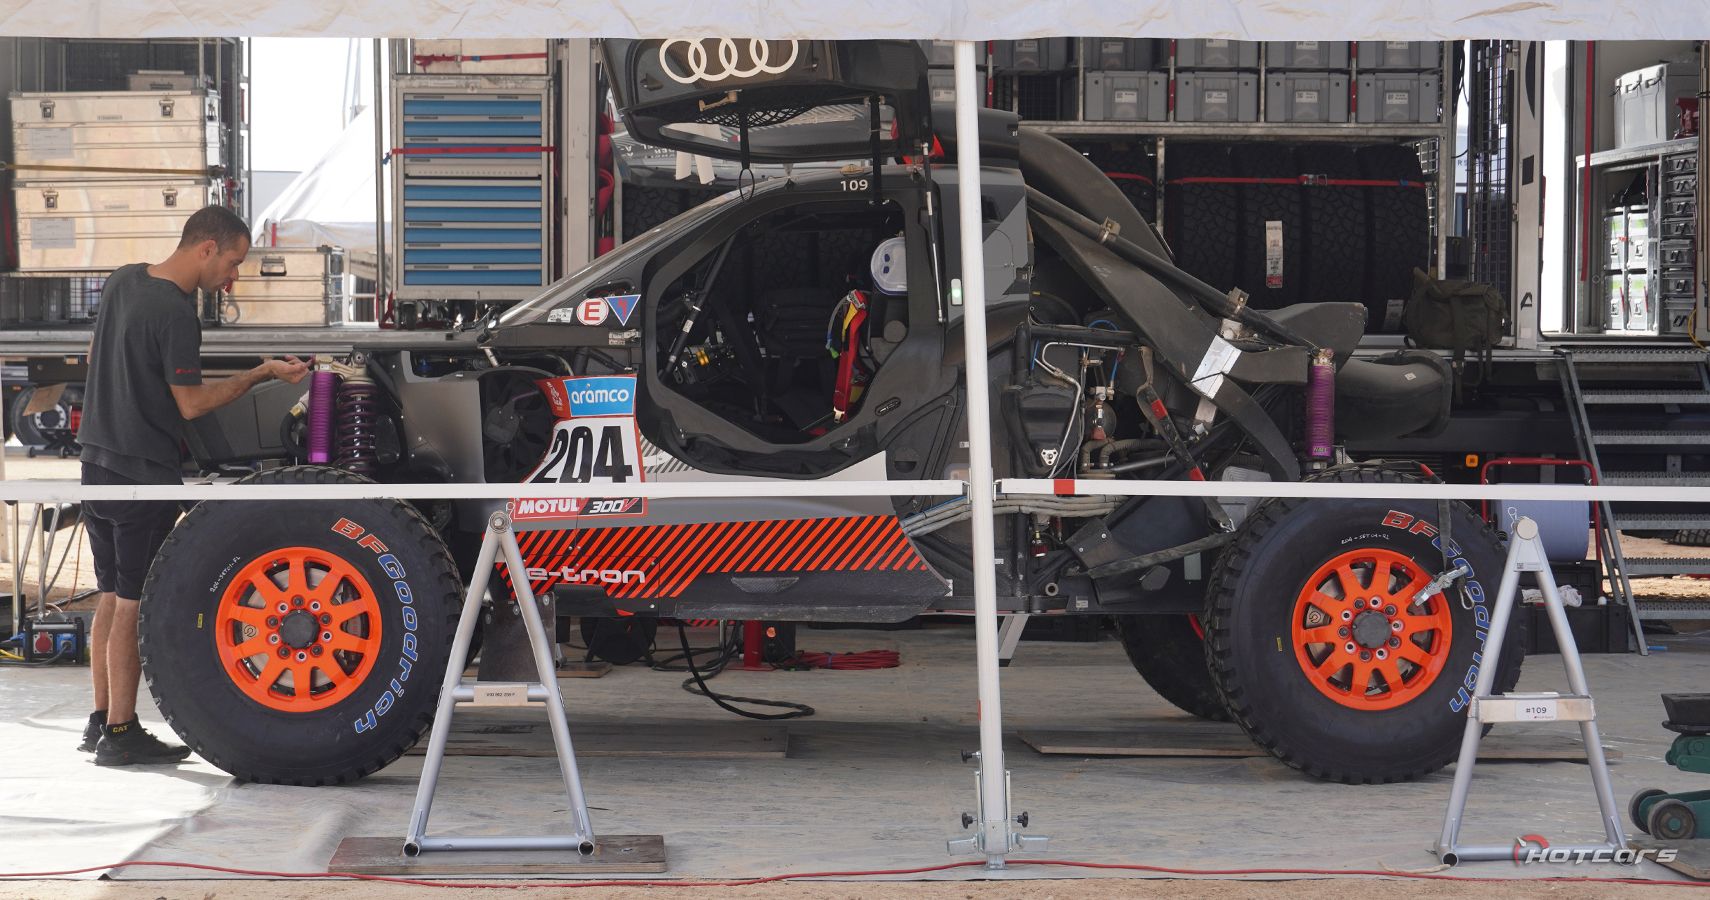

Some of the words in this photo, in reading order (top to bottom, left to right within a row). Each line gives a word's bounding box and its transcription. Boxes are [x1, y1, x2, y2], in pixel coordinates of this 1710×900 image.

[840, 179, 868, 191] 109
[583, 301, 601, 321] E
[571, 385, 630, 404] aramco
[529, 425, 634, 483] 204
[518, 498, 580, 515] MOTUL
[589, 498, 639, 514] 300V
[525, 565, 646, 584] e-tron
[331, 517, 419, 734] BFGoodrich
[1525, 706, 1547, 714] #109
